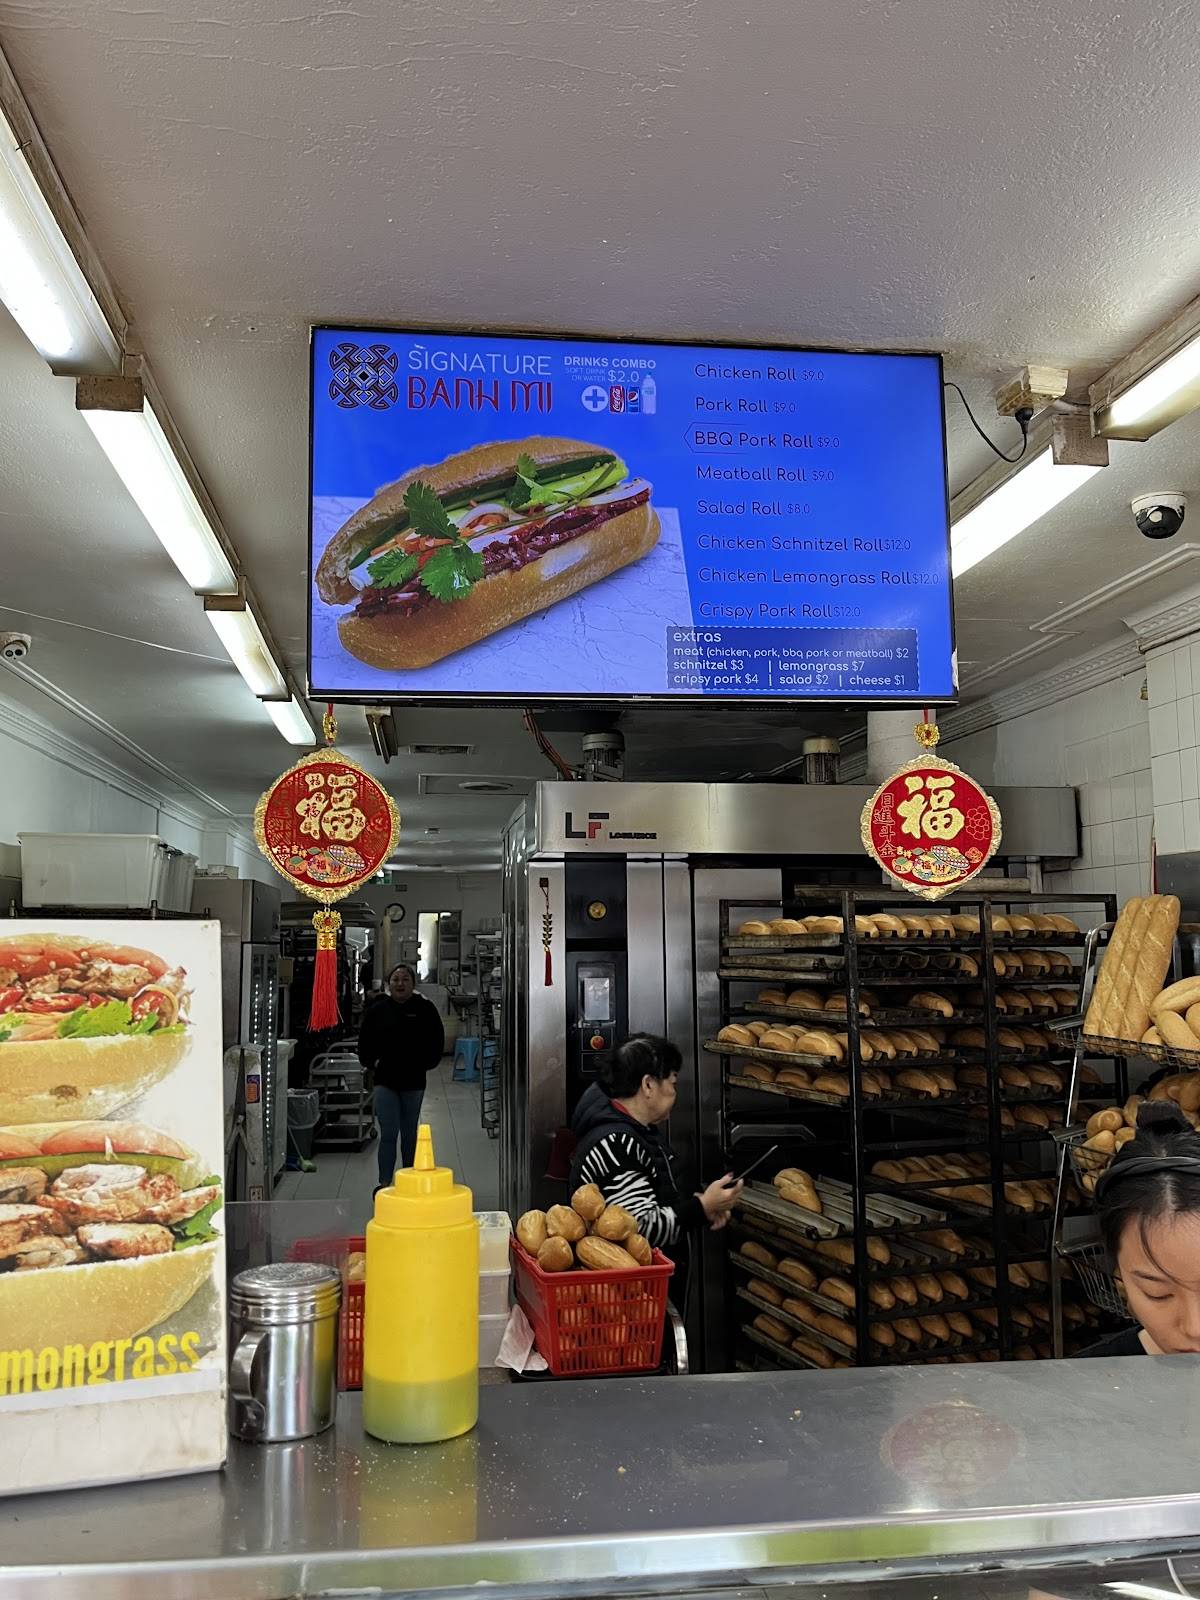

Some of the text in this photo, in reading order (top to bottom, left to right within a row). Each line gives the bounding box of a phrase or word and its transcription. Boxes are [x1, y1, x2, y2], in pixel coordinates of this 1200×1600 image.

[408, 348, 552, 375] SIGNATURE
[564, 356, 656, 369] DRINKS COMBO
[607, 369, 640, 383] $2.0
[694, 363, 825, 381] Chicken Roll $9.0
[408, 375, 552, 413] BANH MI
[695, 397, 796, 413] Pork Roll $9.0
[694, 431, 840, 448] BBQ Pork Roll $9.0
[697, 466, 834, 482] Meatball Roll $9.0
[697, 500, 810, 515] Salad Roll $8.0
[698, 535, 765, 550] Chicken
[771, 536, 848, 551] Schnitzel
[854, 537, 883, 552] Roll
[698, 567, 767, 583] Chicken
[773, 569, 876, 587] Lemongrass
[881, 571, 911, 585] Roll
[700, 602, 754, 620] Crispy
[759, 603, 796, 618] Pork
[802, 604, 833, 618] Roll
[673, 630, 722, 642] extras
[673, 646, 909, 660] meat (chicken, pork, bbq pork or meatball) $2
[673, 659, 865, 673] schnitzel $3 lemongrass $7
[673, 673, 905, 686] cripsy pork $4 salad $2 cheese $1
[295, 772, 367, 841] 福
[897, 775, 965, 840] 福
[0, 1331, 200, 1395] mongrass
